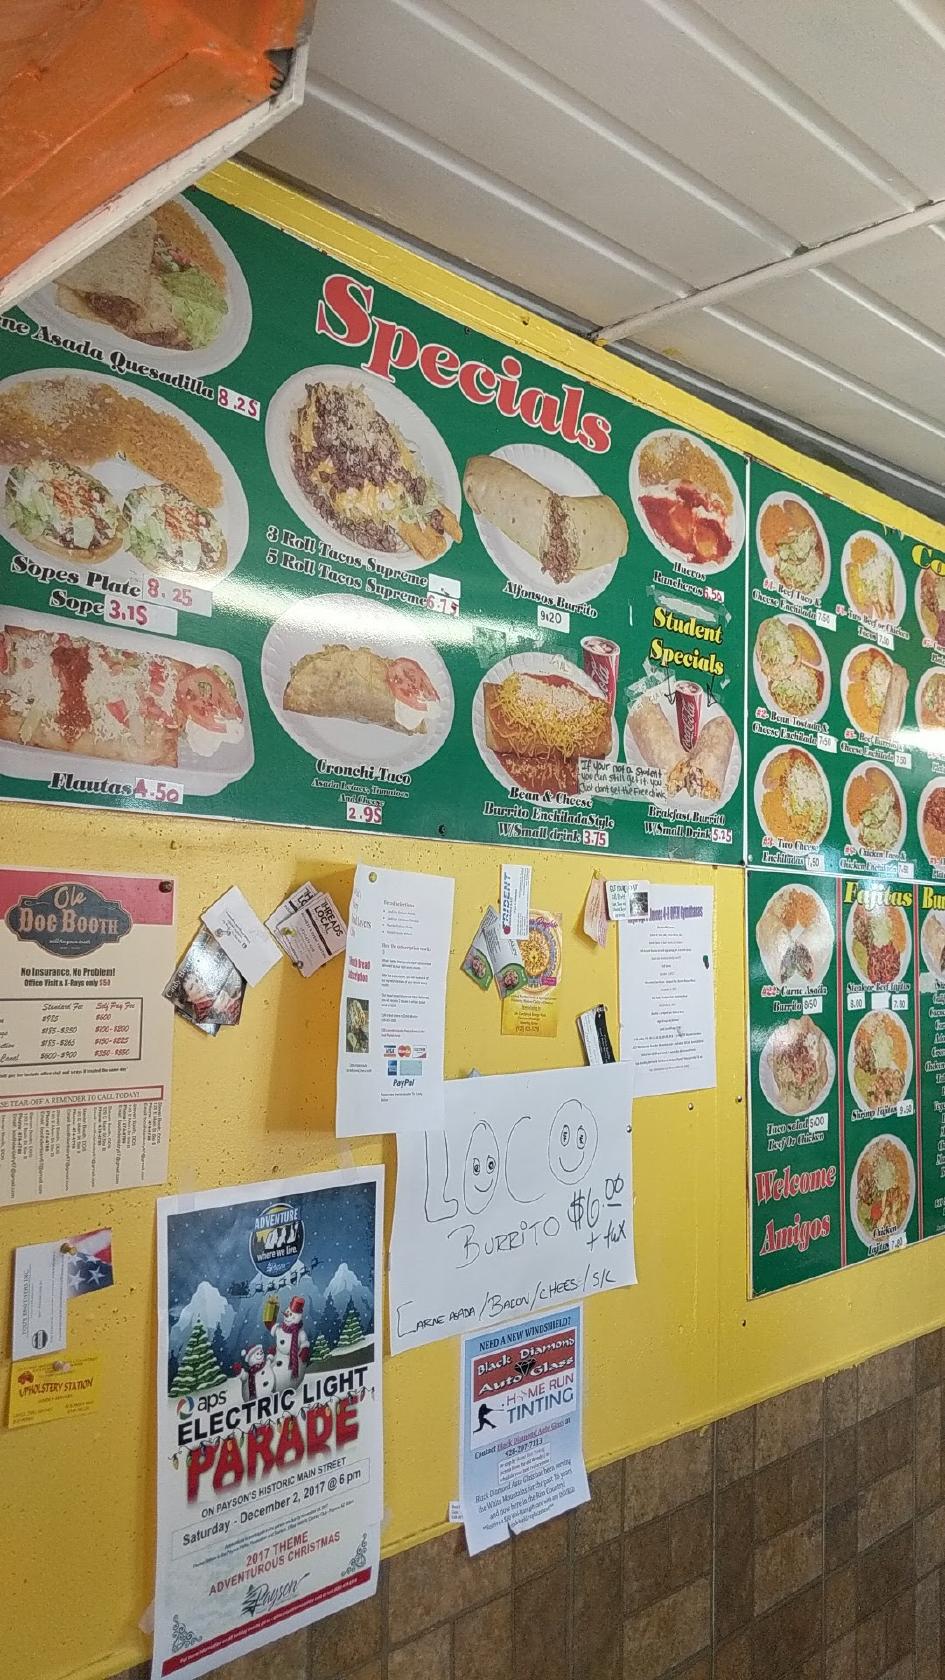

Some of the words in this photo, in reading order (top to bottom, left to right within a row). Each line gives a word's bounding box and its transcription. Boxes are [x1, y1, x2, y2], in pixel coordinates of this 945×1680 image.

[33, 325, 104, 361] Asada
[109, 351, 215, 400] Quesadilla
[316, 274, 611, 454] Specials
[218, 387, 258, 417] 8.25
[267, 526, 278, 542] 3
[282, 530, 316, 553] Roll
[319, 542, 362, 568] Tacos
[365, 557, 428, 587] Supreme
[11, 554, 80, 584] Sopes
[86, 571, 141, 598] Plate
[266, 549, 278, 565] 5
[281, 552, 315, 575] Roll
[318, 563, 362, 588] Tacos
[365, 578, 427, 607] Supreme
[653, 570, 703, 597] Rancheros
[51, 590, 104, 616] Sope
[109, 599, 148, 625] 3.15
[503, 581, 554, 605] Alfonsos
[555, 596, 598, 619] Burrito
[653, 606, 723, 644] Student
[650, 637, 724, 677] Specials
[770, 711, 791, 724] Bean
[752, 722, 779, 736] Cheese
[780, 728, 818, 746] Enchilada
[316, 758, 374, 779] Cronchi
[377, 766, 411, 786] Taco
[593, 761, 611, 775] your
[50, 773, 133, 795] Flautas
[133, 779, 180, 802] 4.50
[483, 801, 529, 820] Burrito
[509, 786, 540, 803] Bean
[543, 790, 556, 803] &
[556, 792, 593, 809] Cheese
[348, 806, 382, 823] 2.95
[497, 822, 549, 839] W/Small
[549, 827, 580, 843] drink
[583, 830, 607, 846] 3.75
[685, 826, 711, 840] Drink
[712, 829, 732, 843] 5.25
[54, 886, 87, 909] Ole
[503, 871, 511, 928] TRIDENT
[843, 881, 913, 911] Fajitas
[314, 905, 330, 935] LOCAL
[321, 900, 343, 937] THREADS
[21, 967, 31, 977] No
[32, 967, 72, 978] Insurance,
[73, 967, 82, 977] No
[83, 967, 116, 977] Problem!
[24, 979, 43, 987] Office
[44, 979, 58, 987] Visit
[85, 979, 98, 988] only
[42, 1002, 72, 1011] Standard
[72, 1002, 84, 1011] Fee
[123, 1001, 136, 1010] Fee
[393, 1079, 415, 1088] PayPal
[51, 1094, 87, 1104] REMINDER
[87, 1094, 97, 1102] TO
[97, 1092, 115, 1101] CALL
[115, 1090, 140, 1099] TODAY!
[851, 1108, 877, 1121] Shrimp
[797, 1131, 825, 1146] Chicken
[424, 1098, 599, 1223] LOCO
[755, 1165, 836, 1206] Welcome
[254, 1207, 299, 1229] ADVENTURE
[447, 1216, 560, 1269] BURRITO
[760, 1213, 830, 1256] Amigos
[873, 1225, 897, 1238] Chicken
[256, 1251, 276, 1262] where
[276, 1248, 285, 1257] we
[397, 1300, 446, 1338] CARNE
[479, 1338, 500, 1351] NEED
[499, 1335, 506, 1346] A
[506, 1331, 524, 1344] NEW
[525, 1316, 572, 1338] WINDSHIELD?
[477, 1354, 511, 1376] Black
[520, 1336, 575, 1360] Diamond
[19, 1382, 63, 1398] UPHOLSTERY
[63, 1377, 94, 1392] STATION
[478, 1373, 522, 1397] Auto
[530, 1355, 575, 1377] Glass
[549, 1372, 575, 1392] RUN
[177, 1388, 297, 1446] ELECTRIC
[301, 1366, 369, 1403] LIGHT
[197, 1391, 226, 1415] aps
[506, 1387, 575, 1424] TINTING
[186, 1396, 361, 1505] PARADE
[474, 1445, 497, 1460] Contact
[201, 1504, 215, 1519] ON
[216, 1490, 257, 1515] PAYSON'S
[258, 1475, 295, 1498] HISTORIC
[297, 1466, 316, 1482] MAIN
[317, 1456, 347, 1476] STREET
[182, 1519, 232, 1547] Saturday
[240, 1498, 292, 1525] December
[304, 1482, 326, 1501] 2017
[327, 1477, 338, 1492] @
[338, 1474, 346, 1486] 6
[346, 1469, 362, 1486] pm
[246, 1547, 271, 1568] 2017
[273, 1530, 310, 1555] THEME
[208, 1555, 286, 1596] ADVENTUROUS
[288, 1531, 341, 1563] CHRISTMAS
